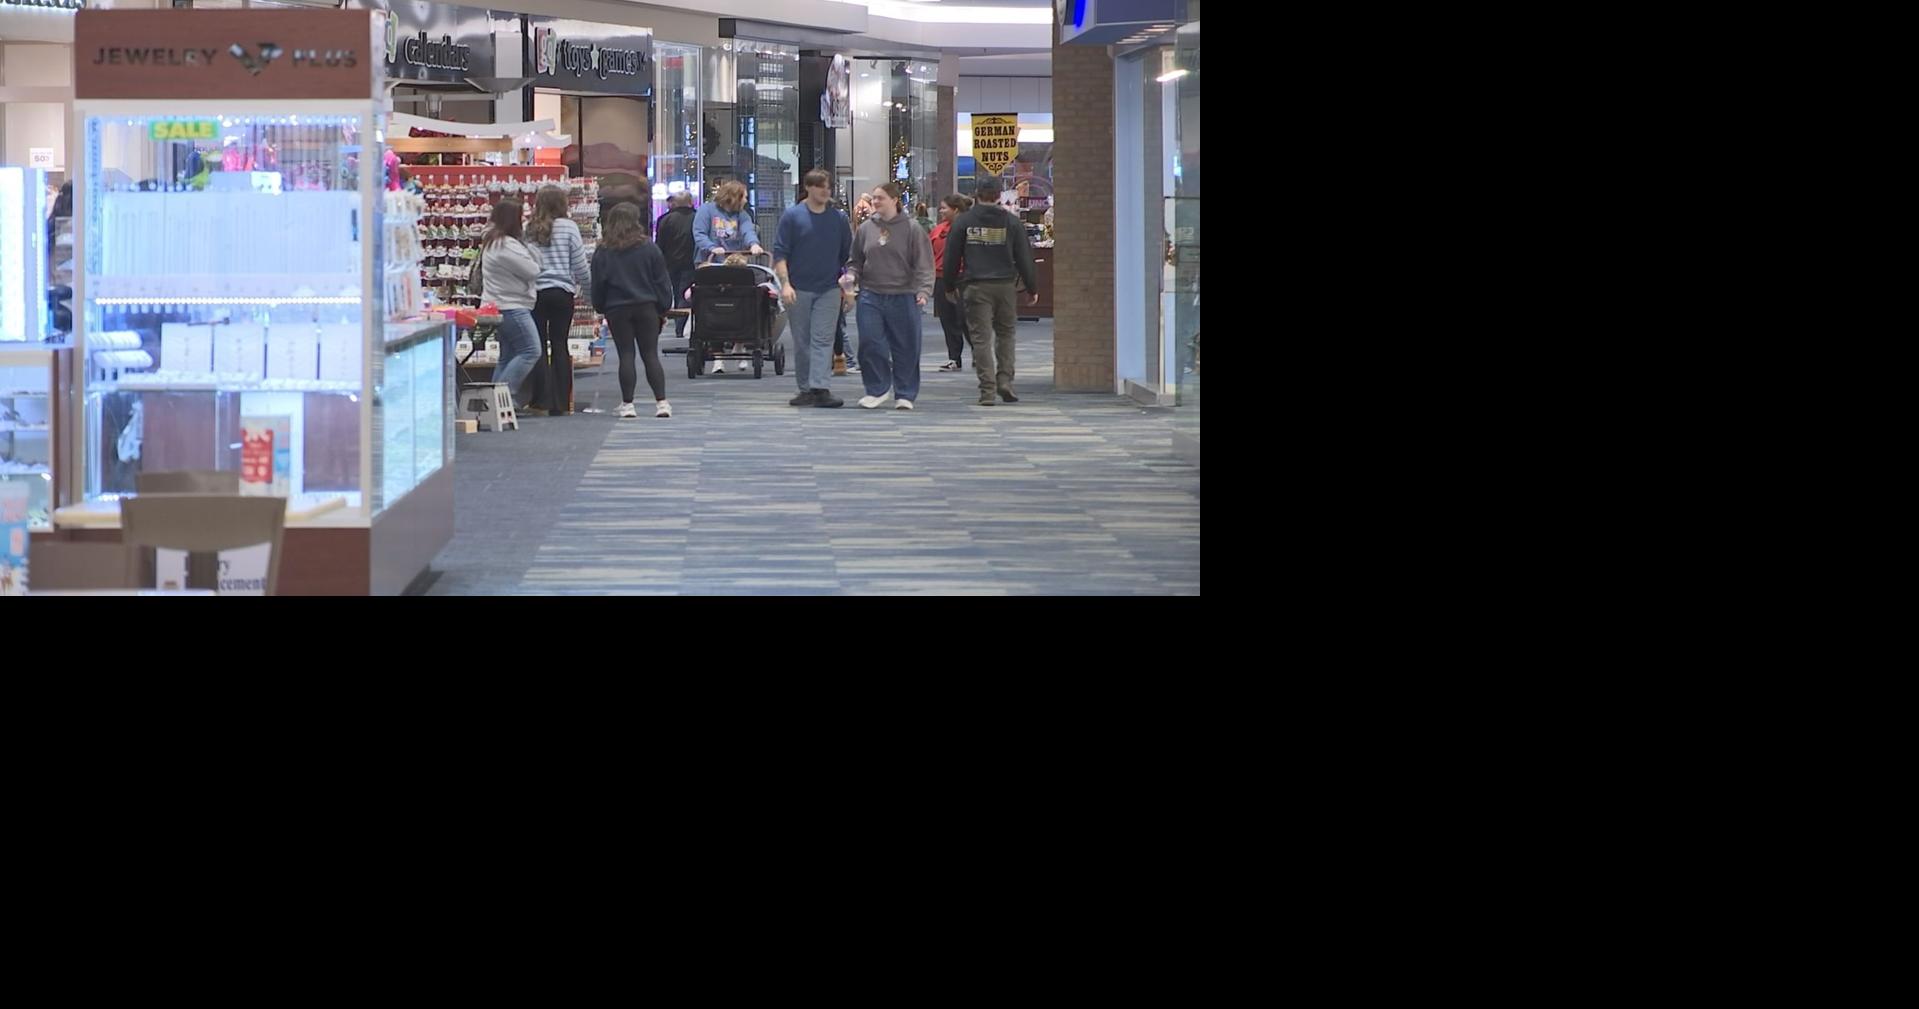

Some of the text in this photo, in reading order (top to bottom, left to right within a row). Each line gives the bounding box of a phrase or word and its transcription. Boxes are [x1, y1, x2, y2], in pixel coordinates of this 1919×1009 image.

[93, 47, 358, 68] JEWELRY PLUS
[563, 40, 591, 77] toys
[153, 121, 214, 139] SALE
[974, 125, 1016, 137] GERMAN
[974, 137, 1017, 149] ROASTED
[981, 151, 1010, 162] NUTS
